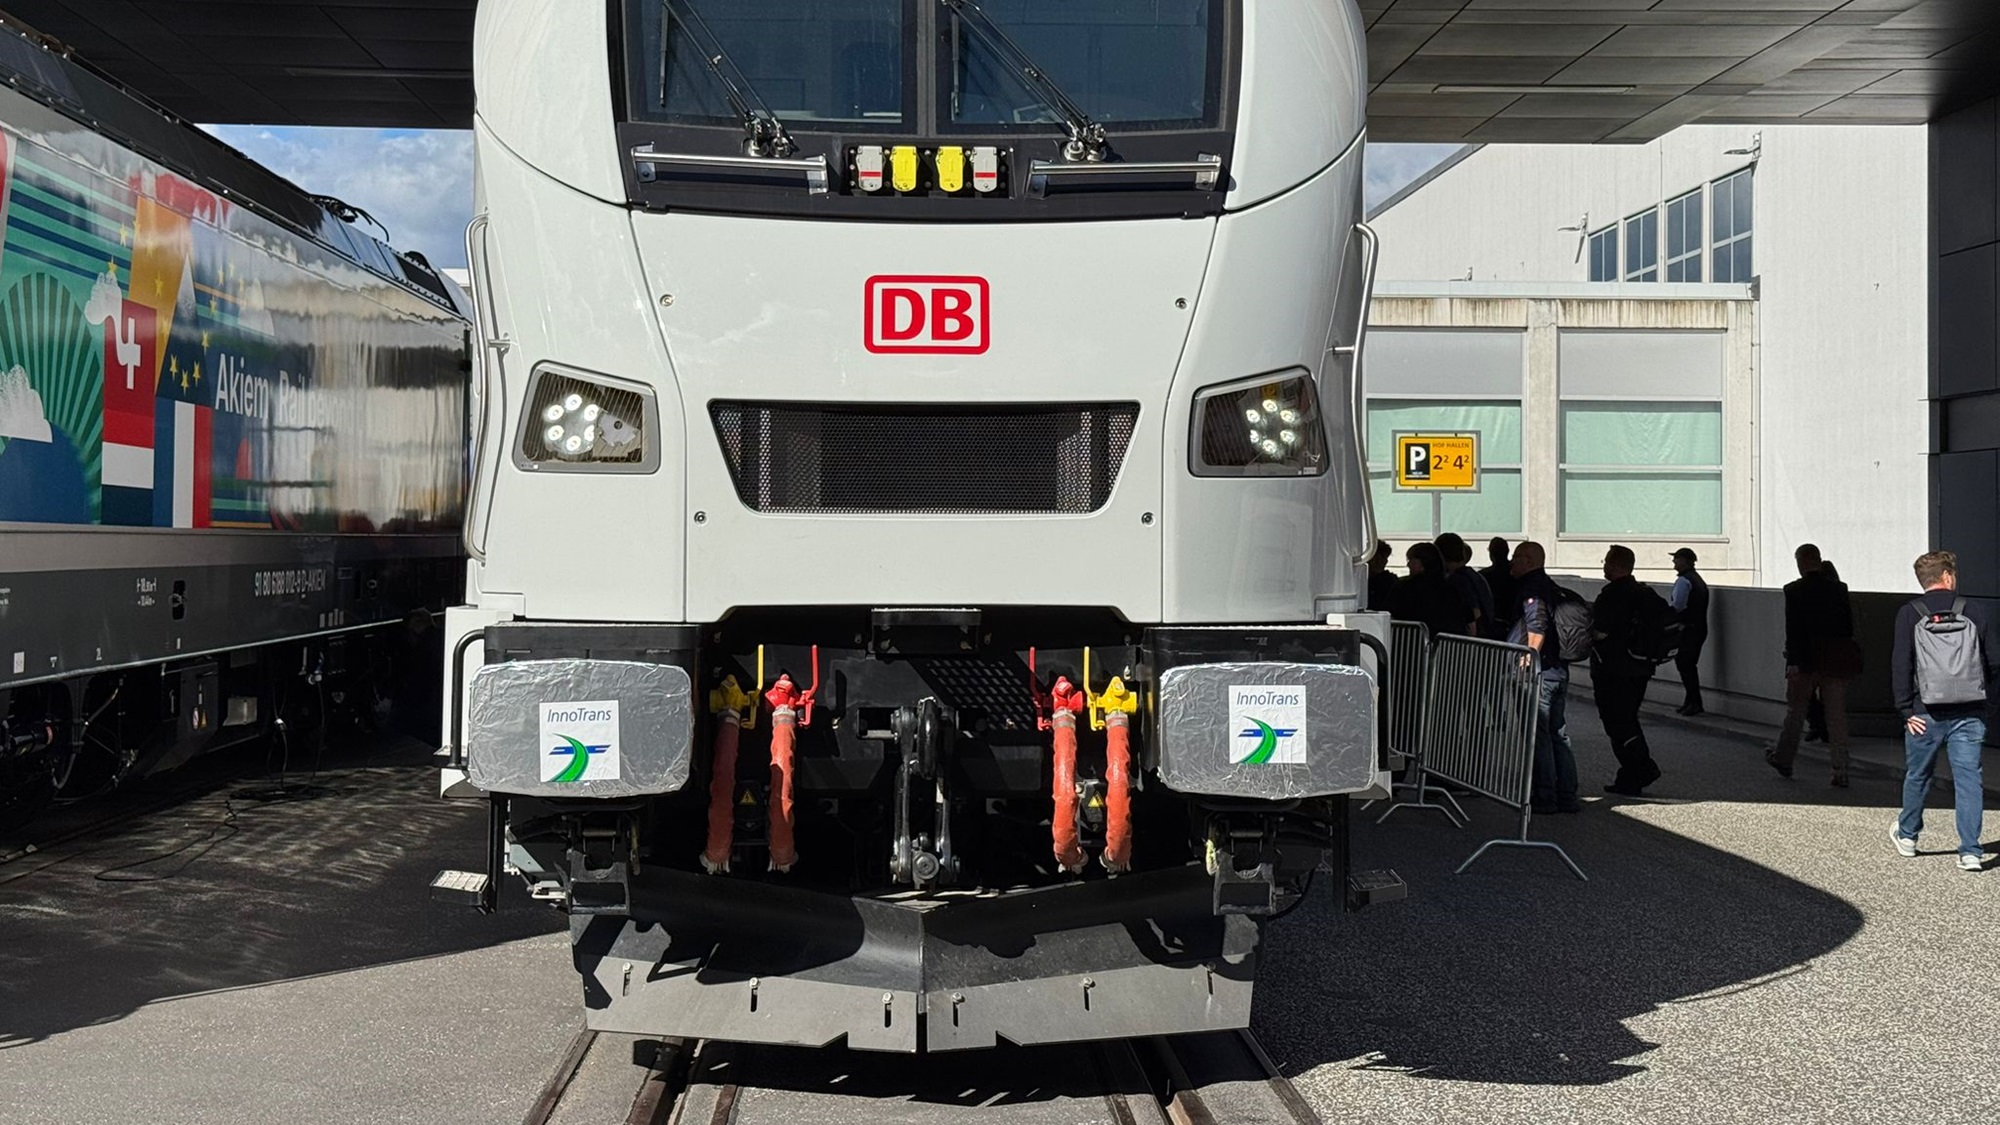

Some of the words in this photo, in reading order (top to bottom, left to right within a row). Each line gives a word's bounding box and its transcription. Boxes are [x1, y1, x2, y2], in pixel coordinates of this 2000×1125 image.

[881, 288, 975, 341] DB
[214, 352, 270, 419] Akiem
[279, 369, 306, 427] Rail
[1410, 446, 1426, 470] P
[1236, 691, 1299, 706] InnoTrans
[547, 707, 612, 723] InnoTrans
